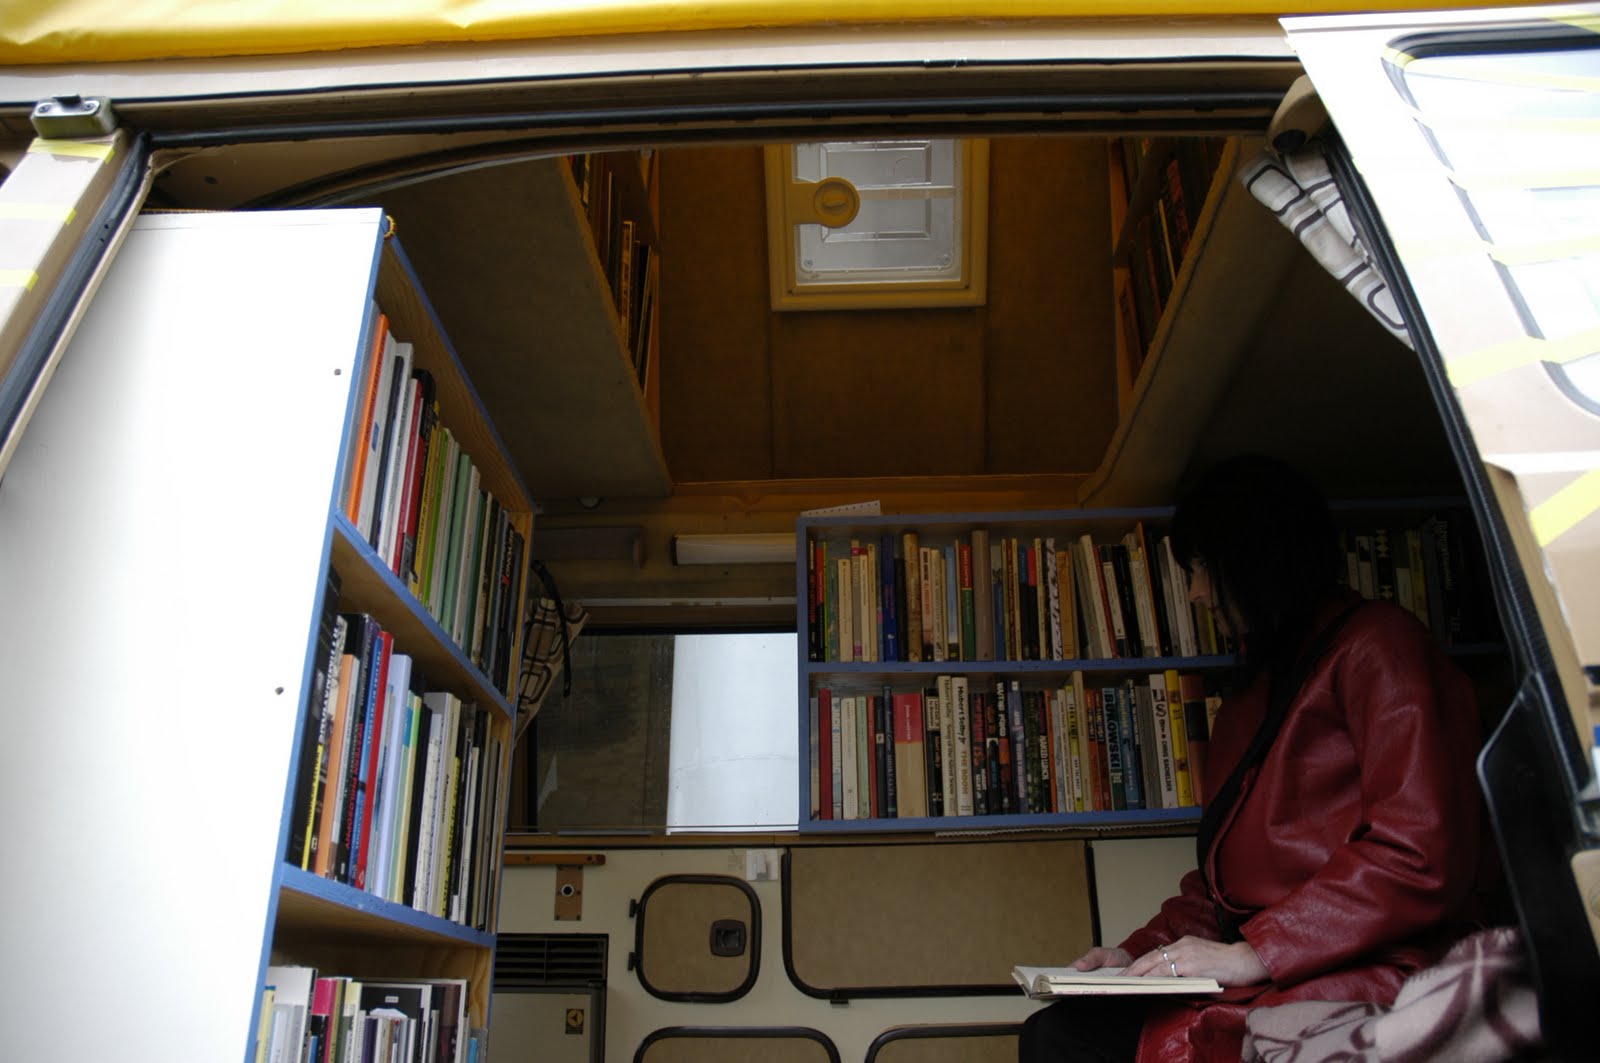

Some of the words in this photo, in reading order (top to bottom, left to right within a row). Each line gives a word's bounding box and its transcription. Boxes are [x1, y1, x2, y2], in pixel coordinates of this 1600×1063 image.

[957, 686, 965, 716] Hubert
[996, 682, 1006, 712] WAITING
[958, 716, 966, 737] Selby
[1105, 694, 1120, 768] BUKOWSKI
[958, 737, 966, 745] Jr
[1040, 735, 1048, 758] NAKED
[960, 750, 968, 767] THE
[1041, 759, 1049, 781] LUNCH
[961, 769, 969, 795] ROOM
[345, 776, 359, 850] PHILOSOPHY
